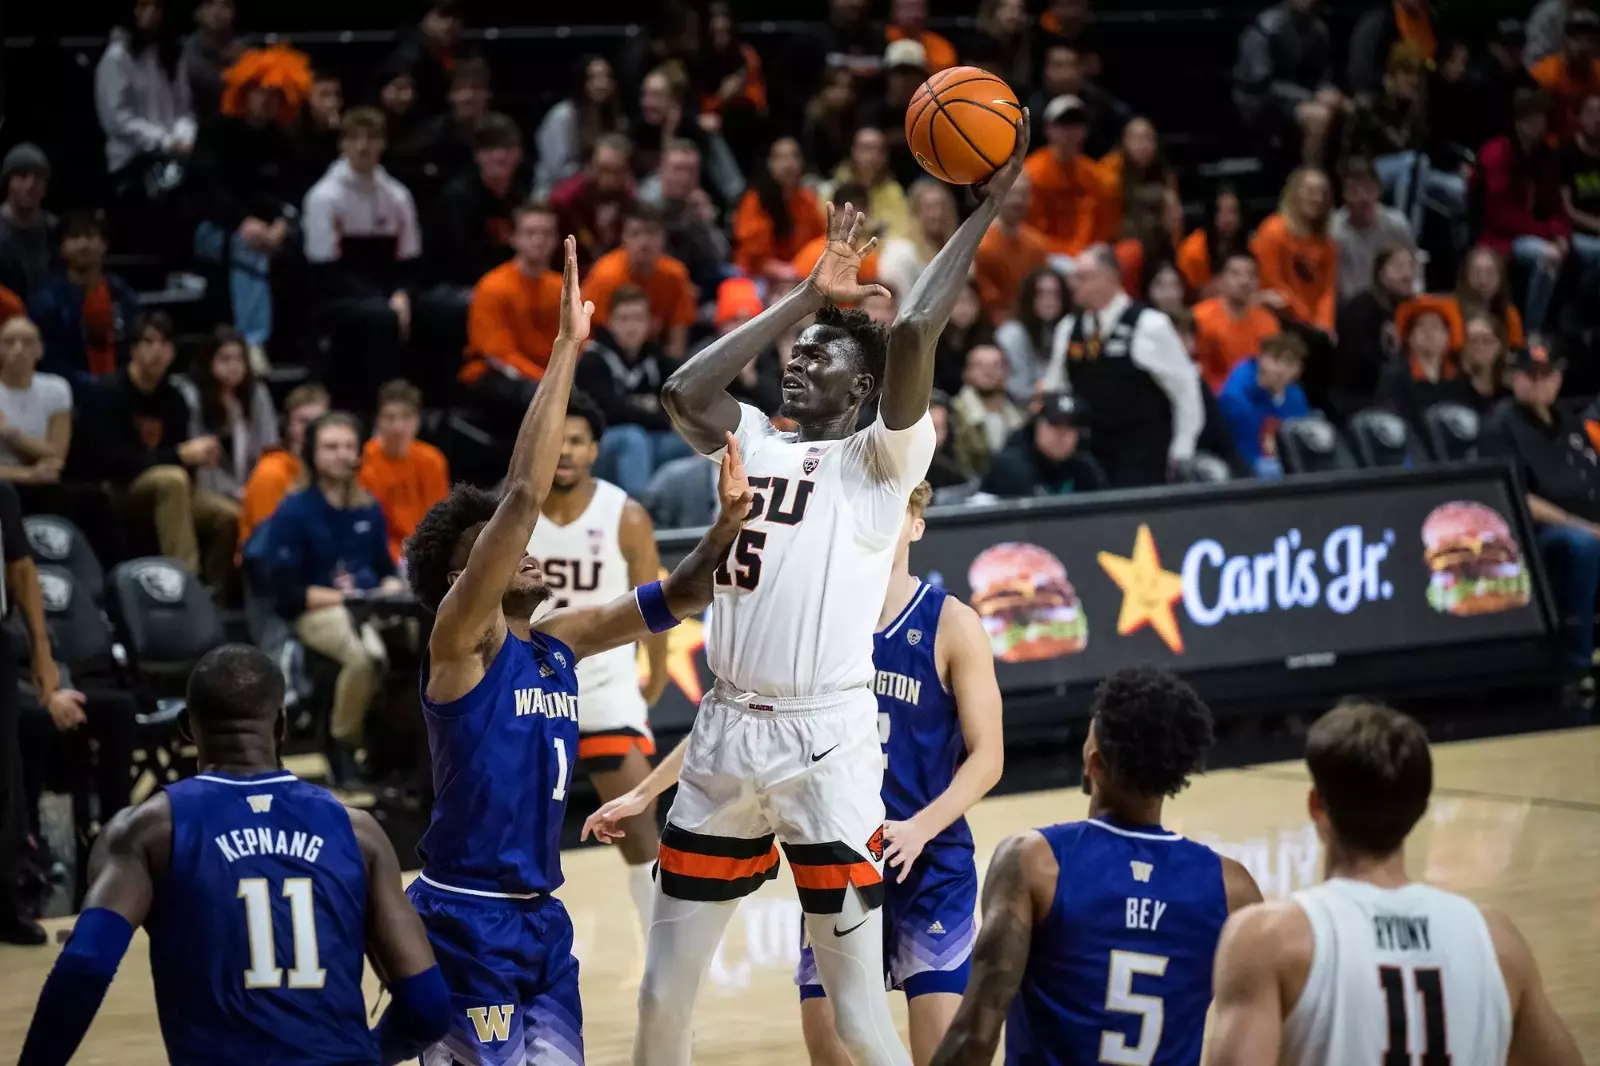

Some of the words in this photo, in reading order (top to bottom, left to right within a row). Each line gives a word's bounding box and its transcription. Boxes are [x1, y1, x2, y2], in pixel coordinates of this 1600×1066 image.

[742, 476, 815, 526] SU
[543, 558, 602, 591] SU
[1181, 527, 1321, 626] Carl's
[1323, 524, 1395, 615] Jr.
[552, 737, 567, 802] 1
[215, 827, 324, 863] KEPNANG
[236, 877, 327, 989] 11
[1125, 897, 1168, 931] BEY
[466, 1004, 515, 1043] W
[1098, 949, 1170, 1066] 5
[1378, 963, 1453, 1066] 11
